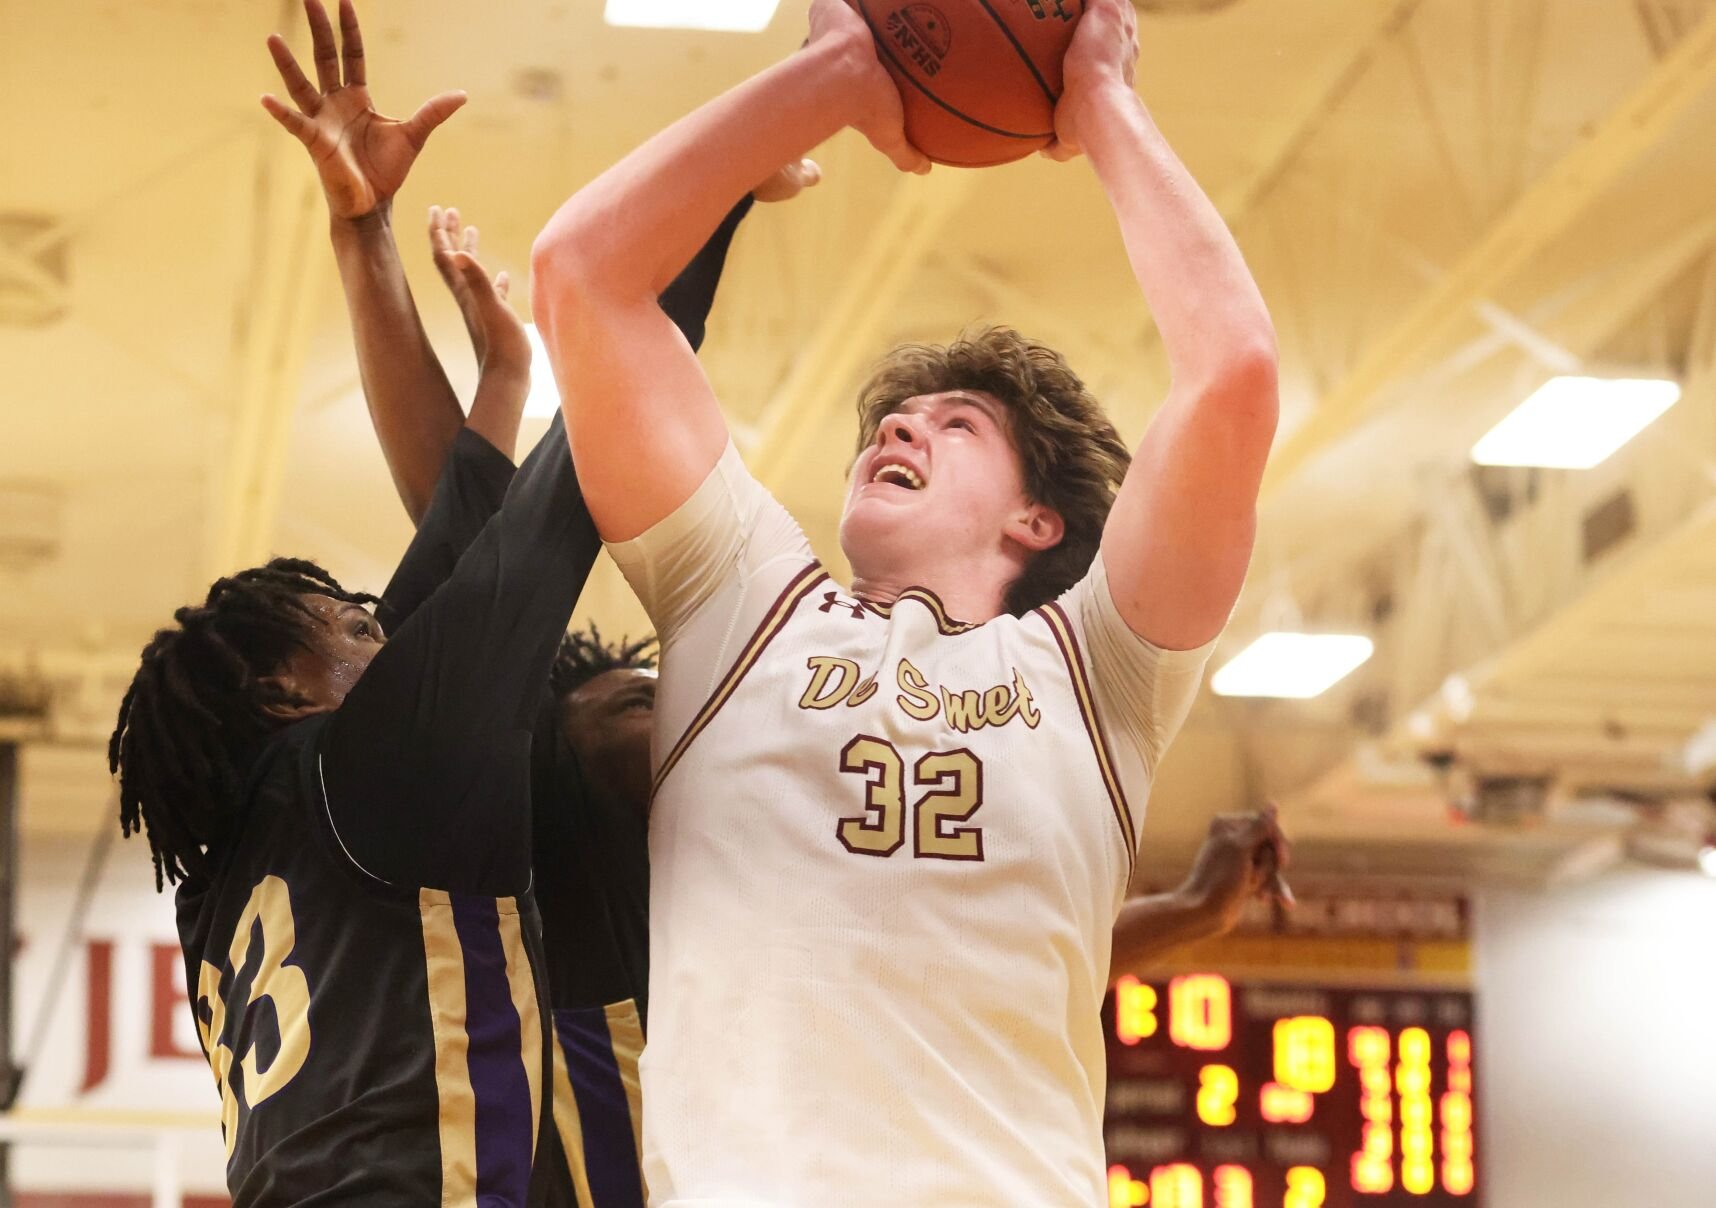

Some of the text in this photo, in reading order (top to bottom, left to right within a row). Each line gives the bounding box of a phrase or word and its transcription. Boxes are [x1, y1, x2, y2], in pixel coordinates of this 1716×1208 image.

[894, 24, 942, 77] NFHS
[798, 656, 1041, 733] De Smet
[836, 733, 984, 862] 32
